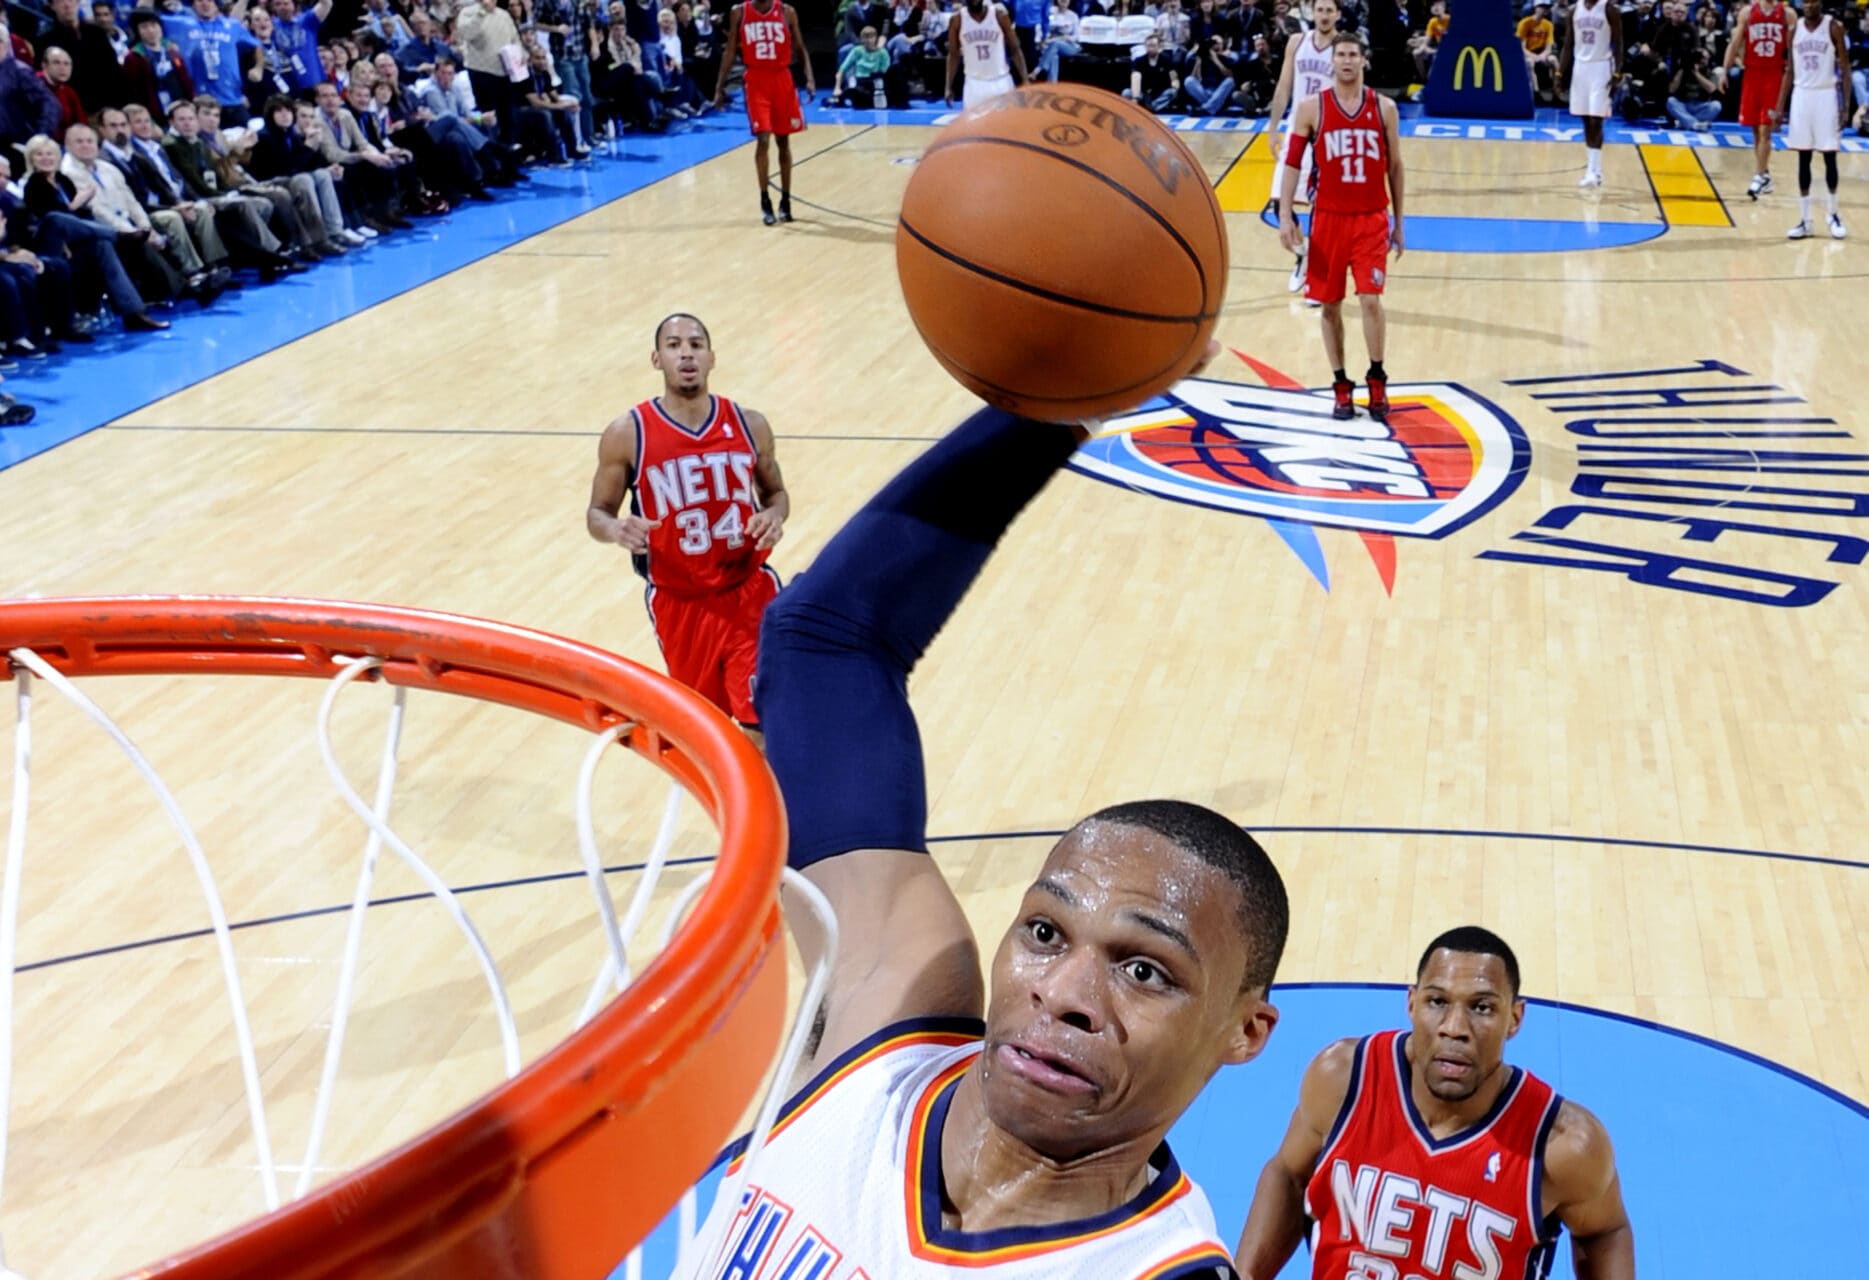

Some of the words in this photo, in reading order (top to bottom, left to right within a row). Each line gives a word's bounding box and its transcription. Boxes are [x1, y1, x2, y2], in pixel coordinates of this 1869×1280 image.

[744, 22, 786, 44] NETS
[1750, 23, 1783, 42] NETS
[755, 41, 777, 60] 21
[975, 45, 990, 60] 13
[1754, 40, 1776, 57] 43
[1304, 76, 1321, 94] 12
[1414, 124, 1583, 141] CITY
[1324, 129, 1380, 161] NETS
[1341, 156, 1366, 183] 11
[646, 452, 753, 520] NETS
[1474, 360, 1869, 607] THUNDER
[675, 503, 744, 555] 34
